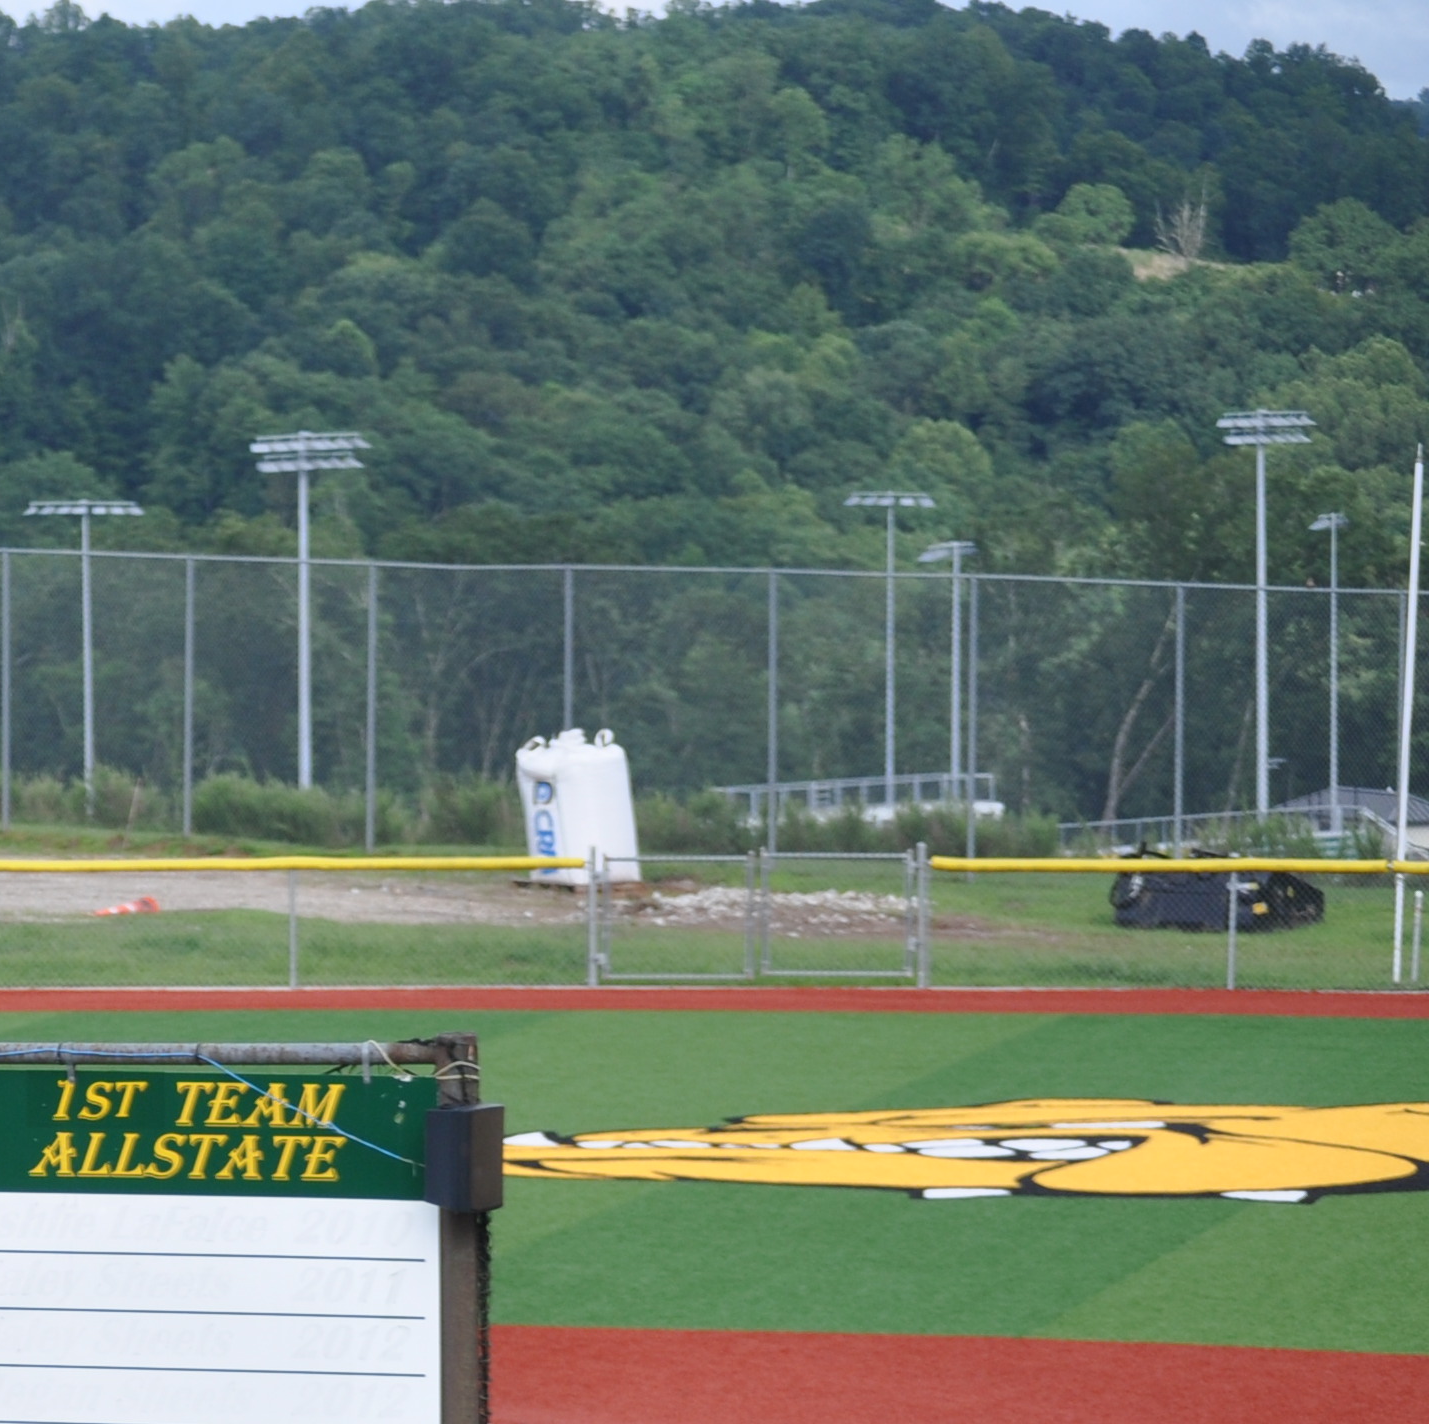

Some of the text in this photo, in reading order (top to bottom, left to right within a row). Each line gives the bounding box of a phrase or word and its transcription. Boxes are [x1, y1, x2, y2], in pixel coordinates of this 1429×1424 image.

[52, 1080, 346, 1129] 1ST TEAM
[28, 1131, 348, 1181] ALLSTATE
